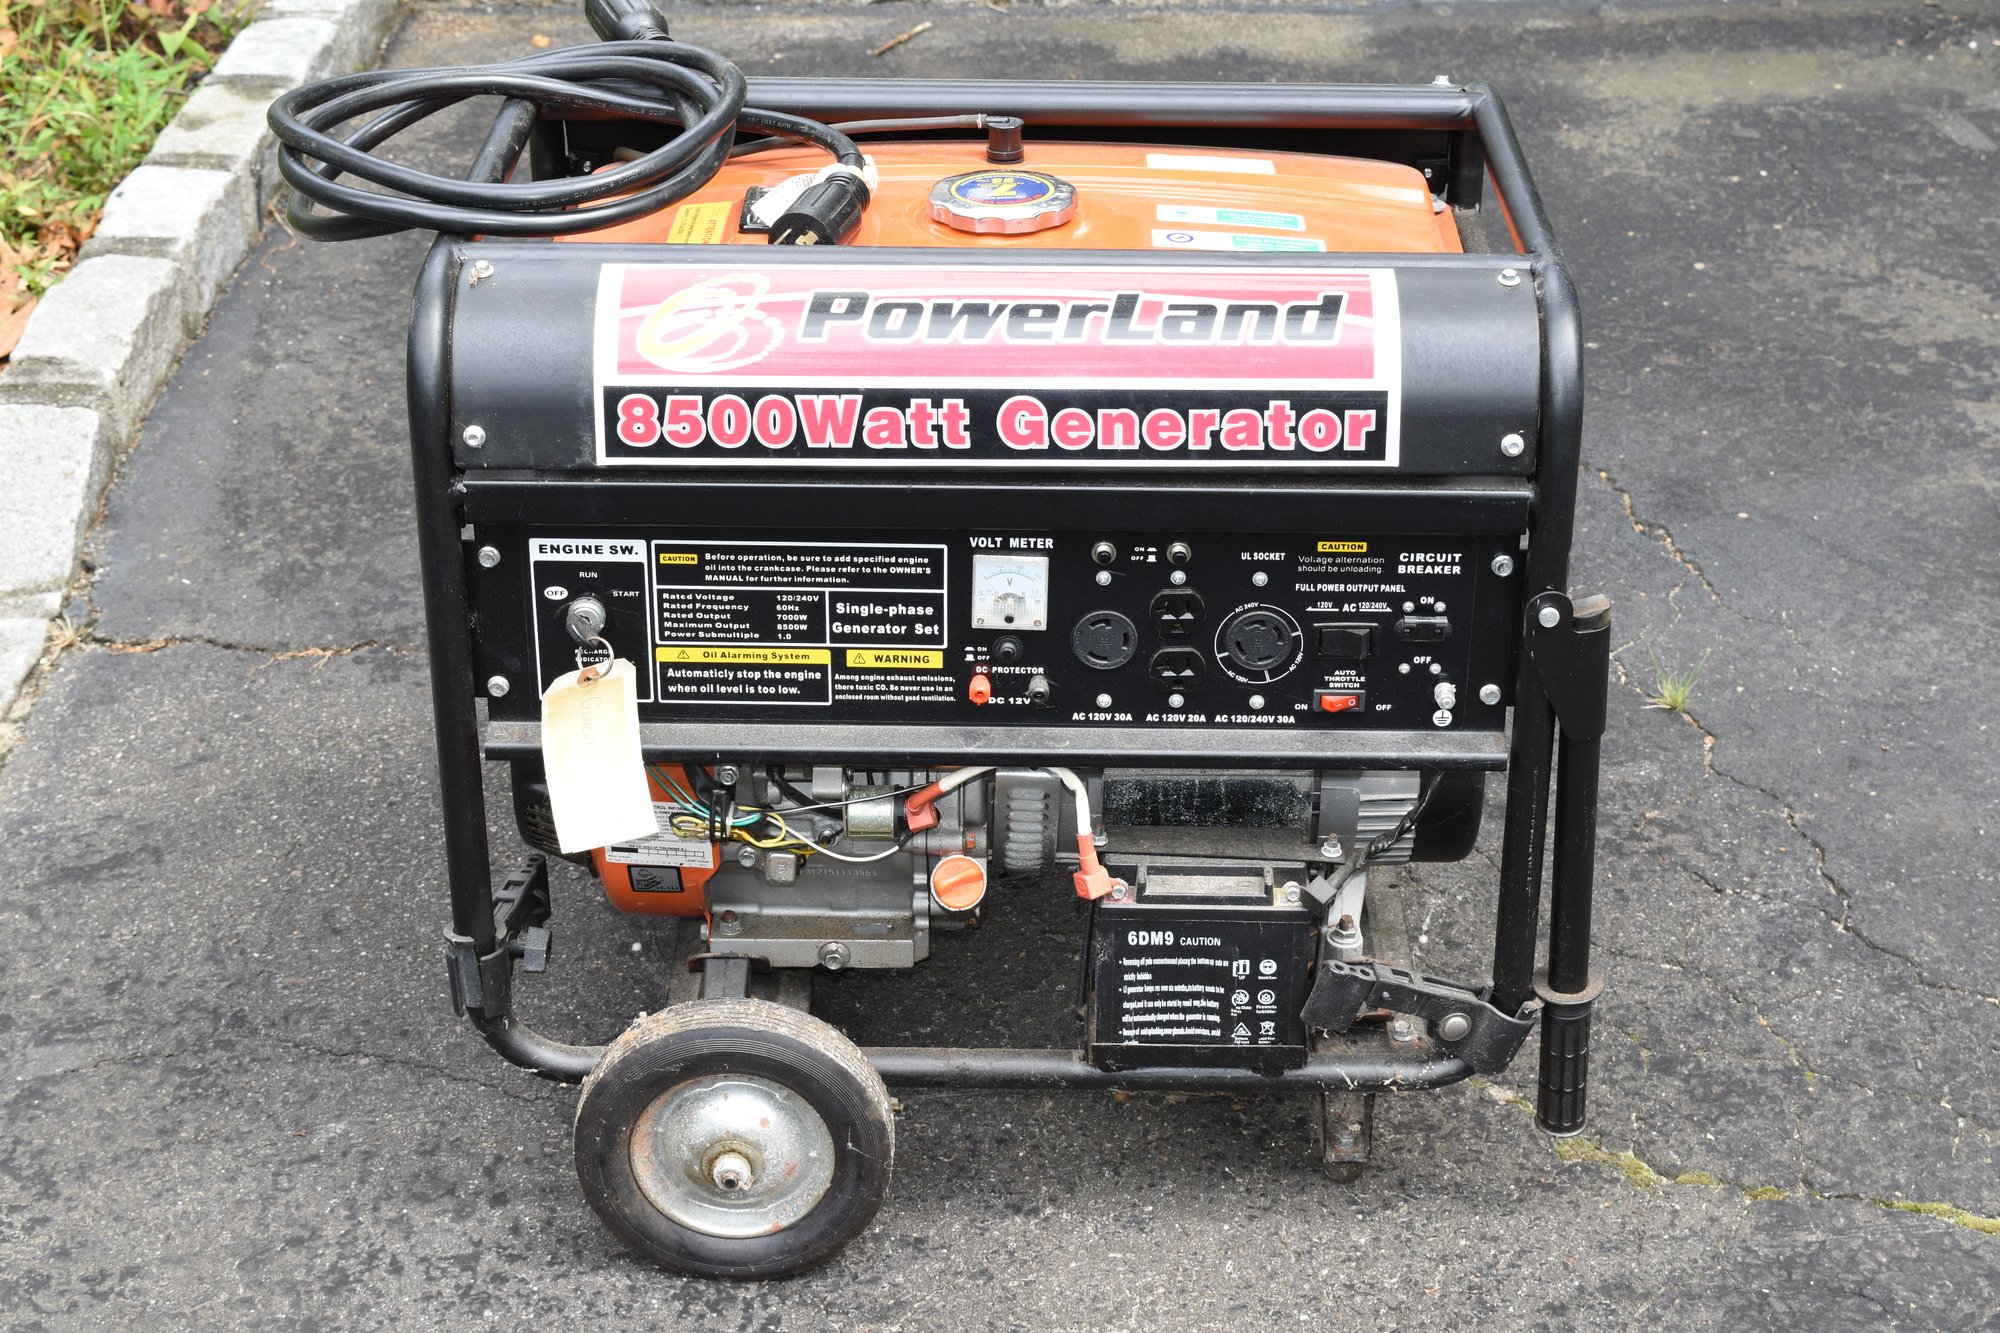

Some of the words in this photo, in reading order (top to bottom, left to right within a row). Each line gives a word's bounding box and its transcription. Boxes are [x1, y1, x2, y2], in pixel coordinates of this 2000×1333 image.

[802, 291, 1344, 344] PowerLand
[617, 395, 971, 448] 8500Watt
[998, 397, 1377, 451] Generator
[969, 537, 1002, 548] VOLT
[1009, 538, 1054, 549] METER
[538, 544, 604, 554] ENGINE
[609, 545, 638, 555] SW.
[705, 553, 735, 561] Before
[738, 554, 785, 562] operation,
[853, 556, 896, 564] specified
[1241, 552, 1251, 561] UL
[1254, 552, 1285, 561] SOCKET
[1335, 556, 1384, 564] alternation
[1400, 553, 1462, 563] CIRCUIT
[1340, 566, 1384, 574] unloading.
[1398, 565, 1461, 574] BREAKER
[1007, 578, 1013, 586] V
[1295, 583, 1315, 591] FULL
[1317, 584, 1344, 592] POWER
[1347, 584, 1379, 592] OUTPUT
[1380, 585, 1406, 593] PANEL
[695, 594, 735, 602] Voltage
[695, 603, 749, 611] Frequency
[836, 603, 933, 617] Single-phase
[1342, 603, 1356, 612] AC
[664, 621, 713, 629] Maximum
[715, 622, 750, 630] Output
[832, 622, 907, 634] Generator
[915, 623, 939, 635] Set
[698, 631, 759, 639] Submultiple
[703, 651, 717, 659] Oil
[721, 652, 768, 661] Alarming
[771, 652, 810, 661] System
[874, 654, 930, 664] WARNING
[1413, 656, 1432, 664] OFF
[667, 668, 734, 680] Automaticly
[737, 669, 761, 680] stop
[764, 670, 781, 679] the
[784, 670, 822, 681] engine
[992, 666, 1044, 674] PROTECTOR
[834, 673, 859, 681] Among
[861, 674, 885, 682] engine
[917, 675, 956, 683] emissions,
[668, 684, 698, 693] when
[700, 684, 713, 693] oil
[717, 685, 743, 694] level
[745, 685, 755, 694] is
[758, 686, 776, 694] too
[778, 685, 800, 694] low.
[1008, 697, 1031, 705] 12V
[1072, 712, 1086, 721] AC
[1088, 713, 1112, 721] 120V
[1114, 713, 1133, 721] 30A
[1146, 714, 1160, 722] AC
[1162, 714, 1186, 722] 120V
[1188, 714, 1206, 722] 20A
[1214, 715, 1228, 723] AC
[1230, 714, 1275, 723] 120/240V
[1277, 715, 1295, 724] 30A
[1127, 931, 1174, 946] 6DM9
[1180, 937, 1221, 946] CAUTION
